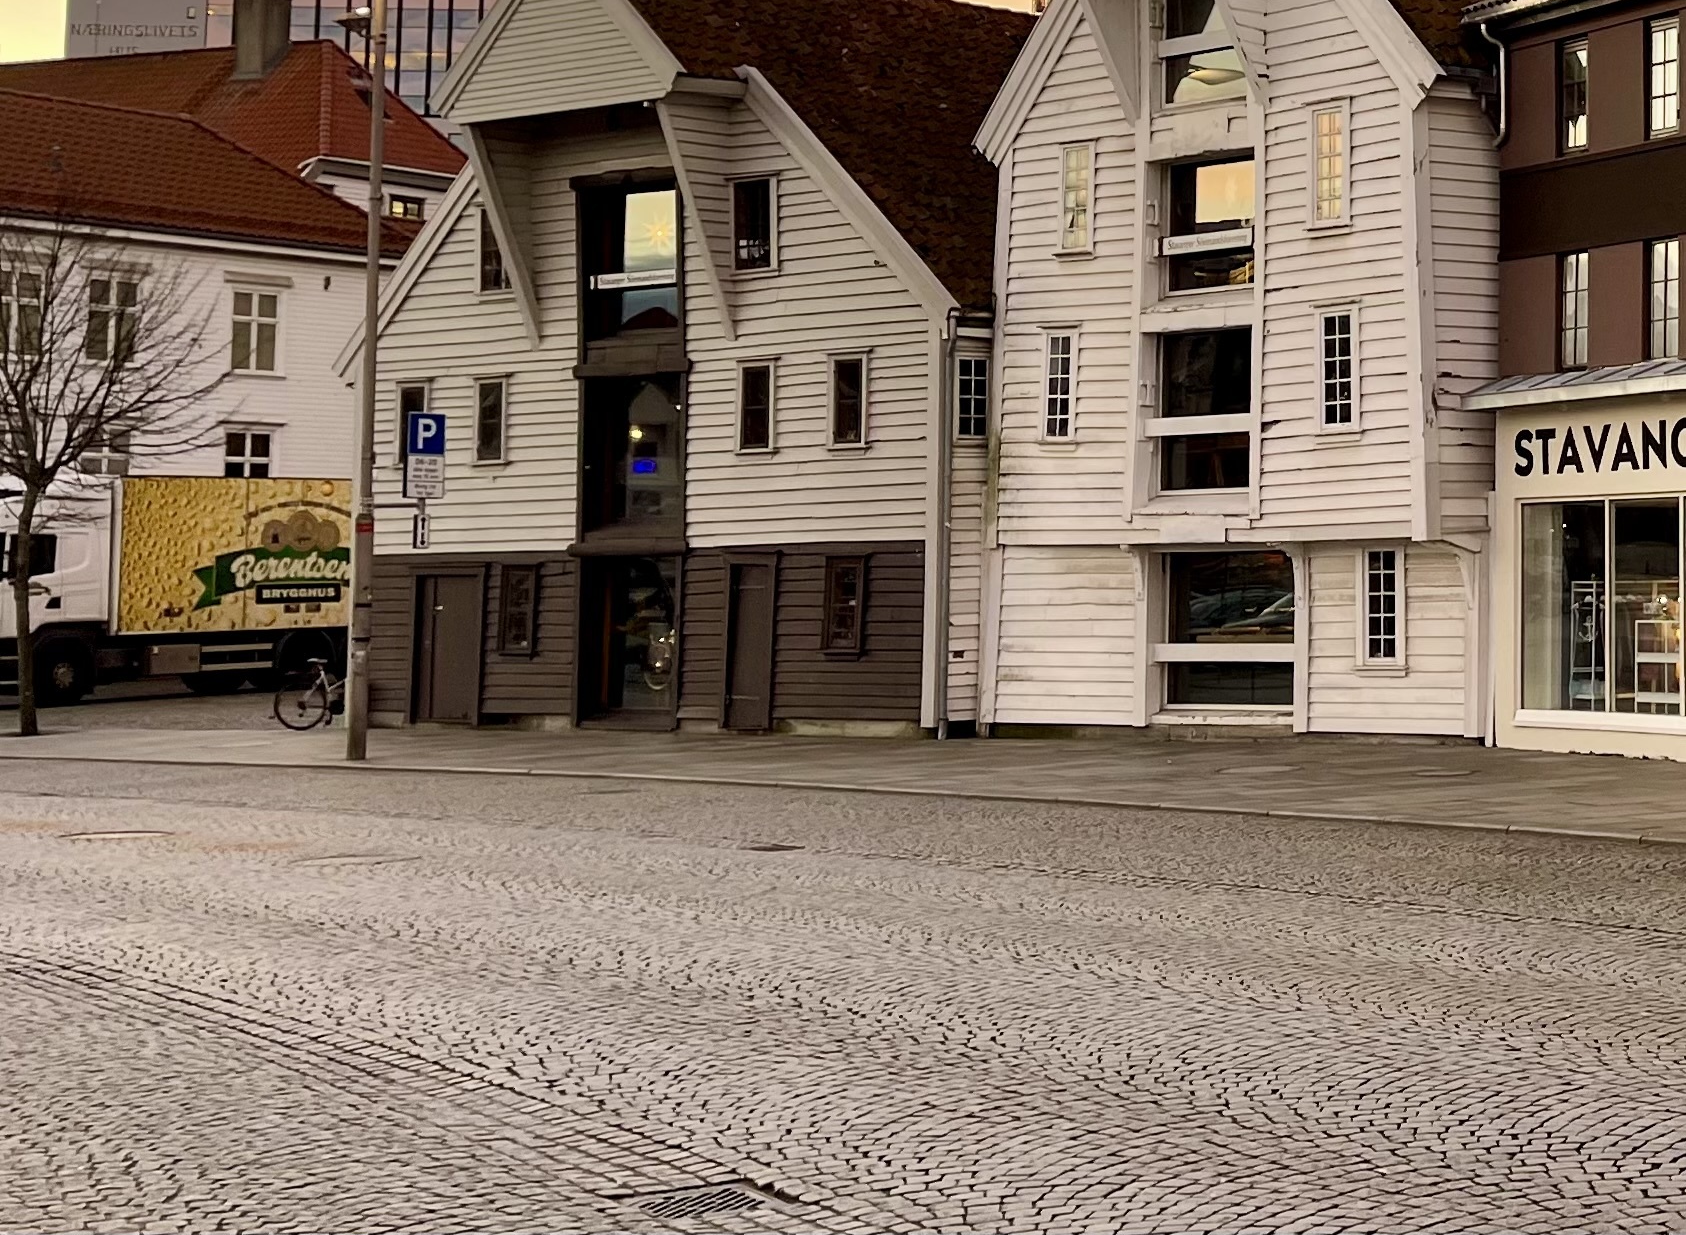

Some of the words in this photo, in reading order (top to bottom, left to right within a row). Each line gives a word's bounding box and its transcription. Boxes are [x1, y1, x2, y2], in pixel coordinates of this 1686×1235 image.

[71, 23, 199, 38] NÆRINGSLIVETS
[417, 418, 437, 449] P
[230, 551, 351, 588] Berentsen
[261, 587, 336, 599] BRYGGHUS
